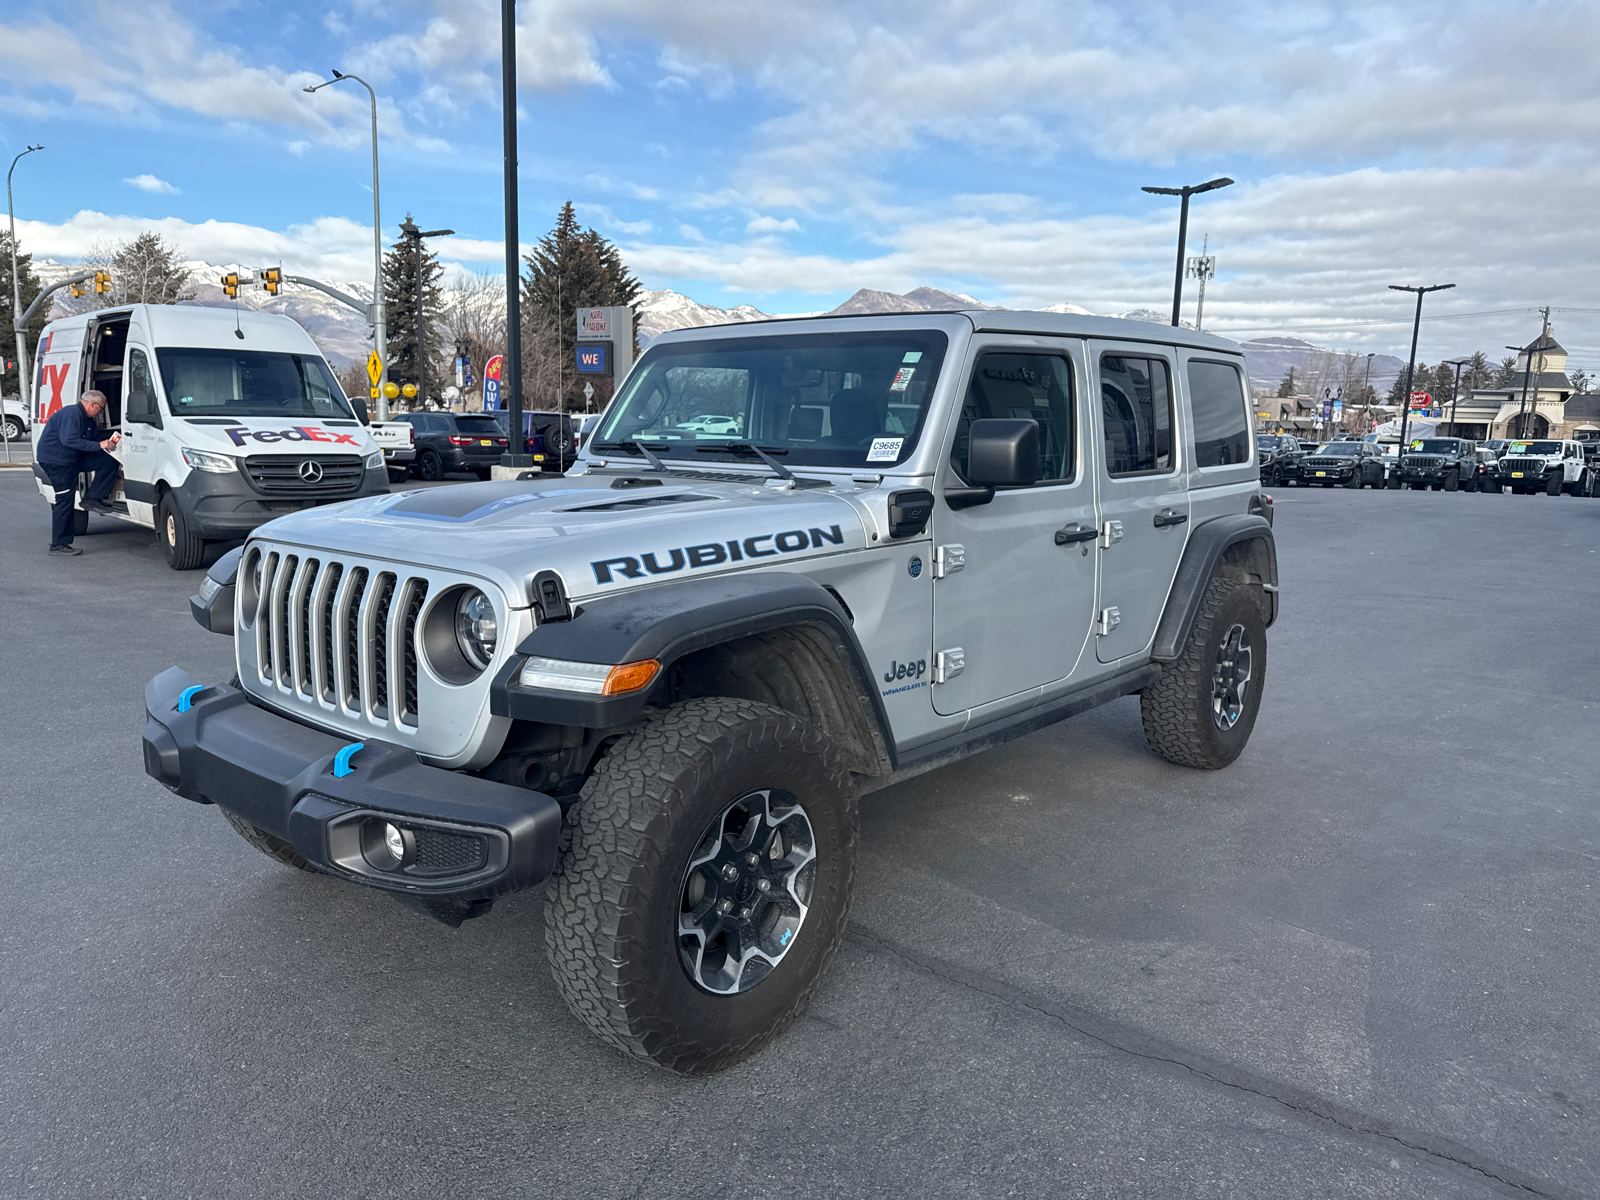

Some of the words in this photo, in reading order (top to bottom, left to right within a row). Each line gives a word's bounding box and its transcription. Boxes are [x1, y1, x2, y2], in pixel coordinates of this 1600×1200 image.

[488, 358, 502, 378] PRE
[582, 353, 599, 365] WE
[224, 426, 363, 448] FedEx
[873, 441, 901, 450] C9685
[590, 524, 844, 585] RUBICON
[884, 658, 926, 683] Jeep
[882, 683, 920, 697] WRANGLER
